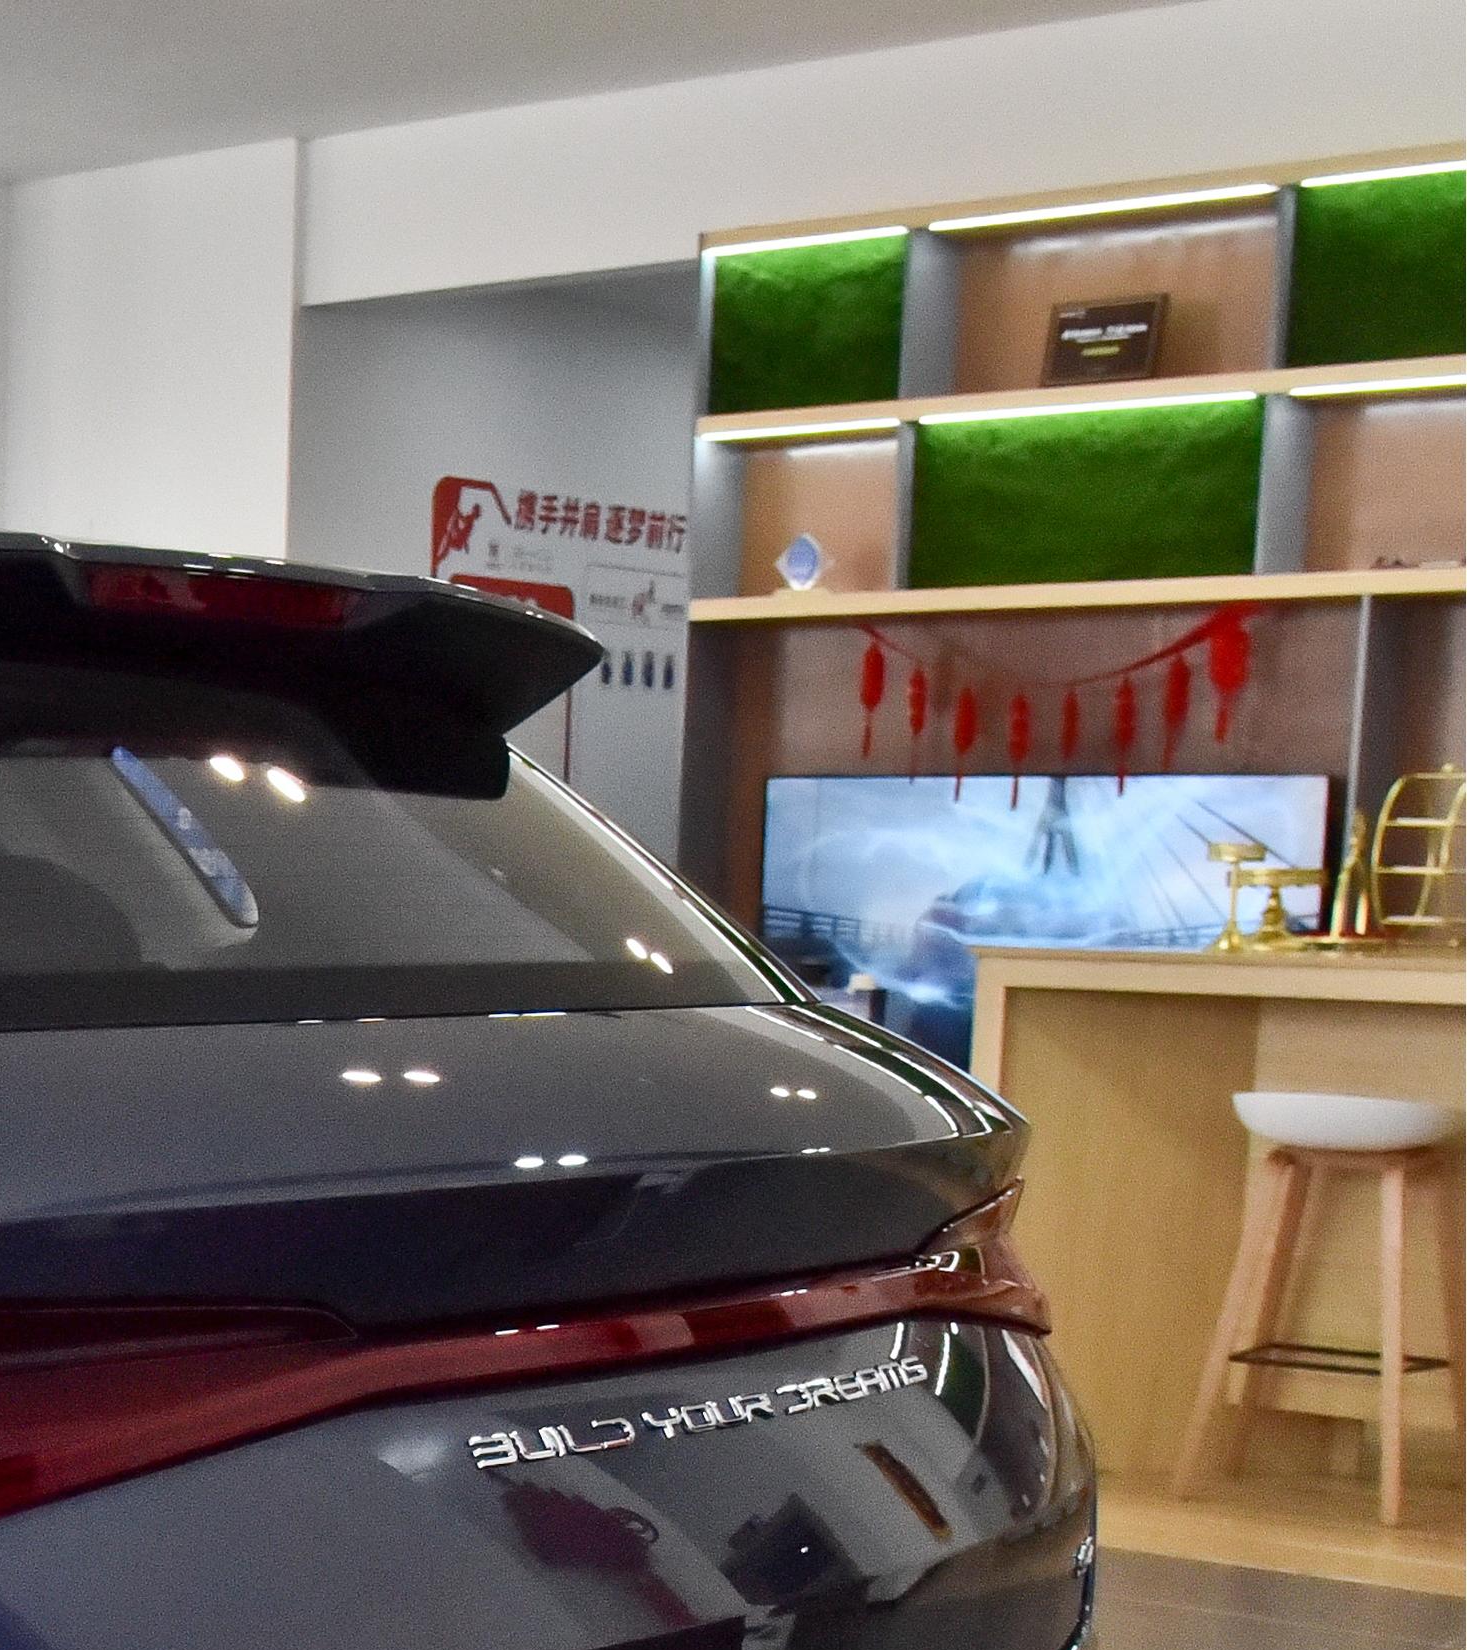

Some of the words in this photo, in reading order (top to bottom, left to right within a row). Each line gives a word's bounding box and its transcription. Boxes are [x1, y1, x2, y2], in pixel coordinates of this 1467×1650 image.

[468, 1416, 635, 1470] BUILD
[640, 1393, 774, 1439] YOUR
[775, 1356, 929, 1416] DREAMS
